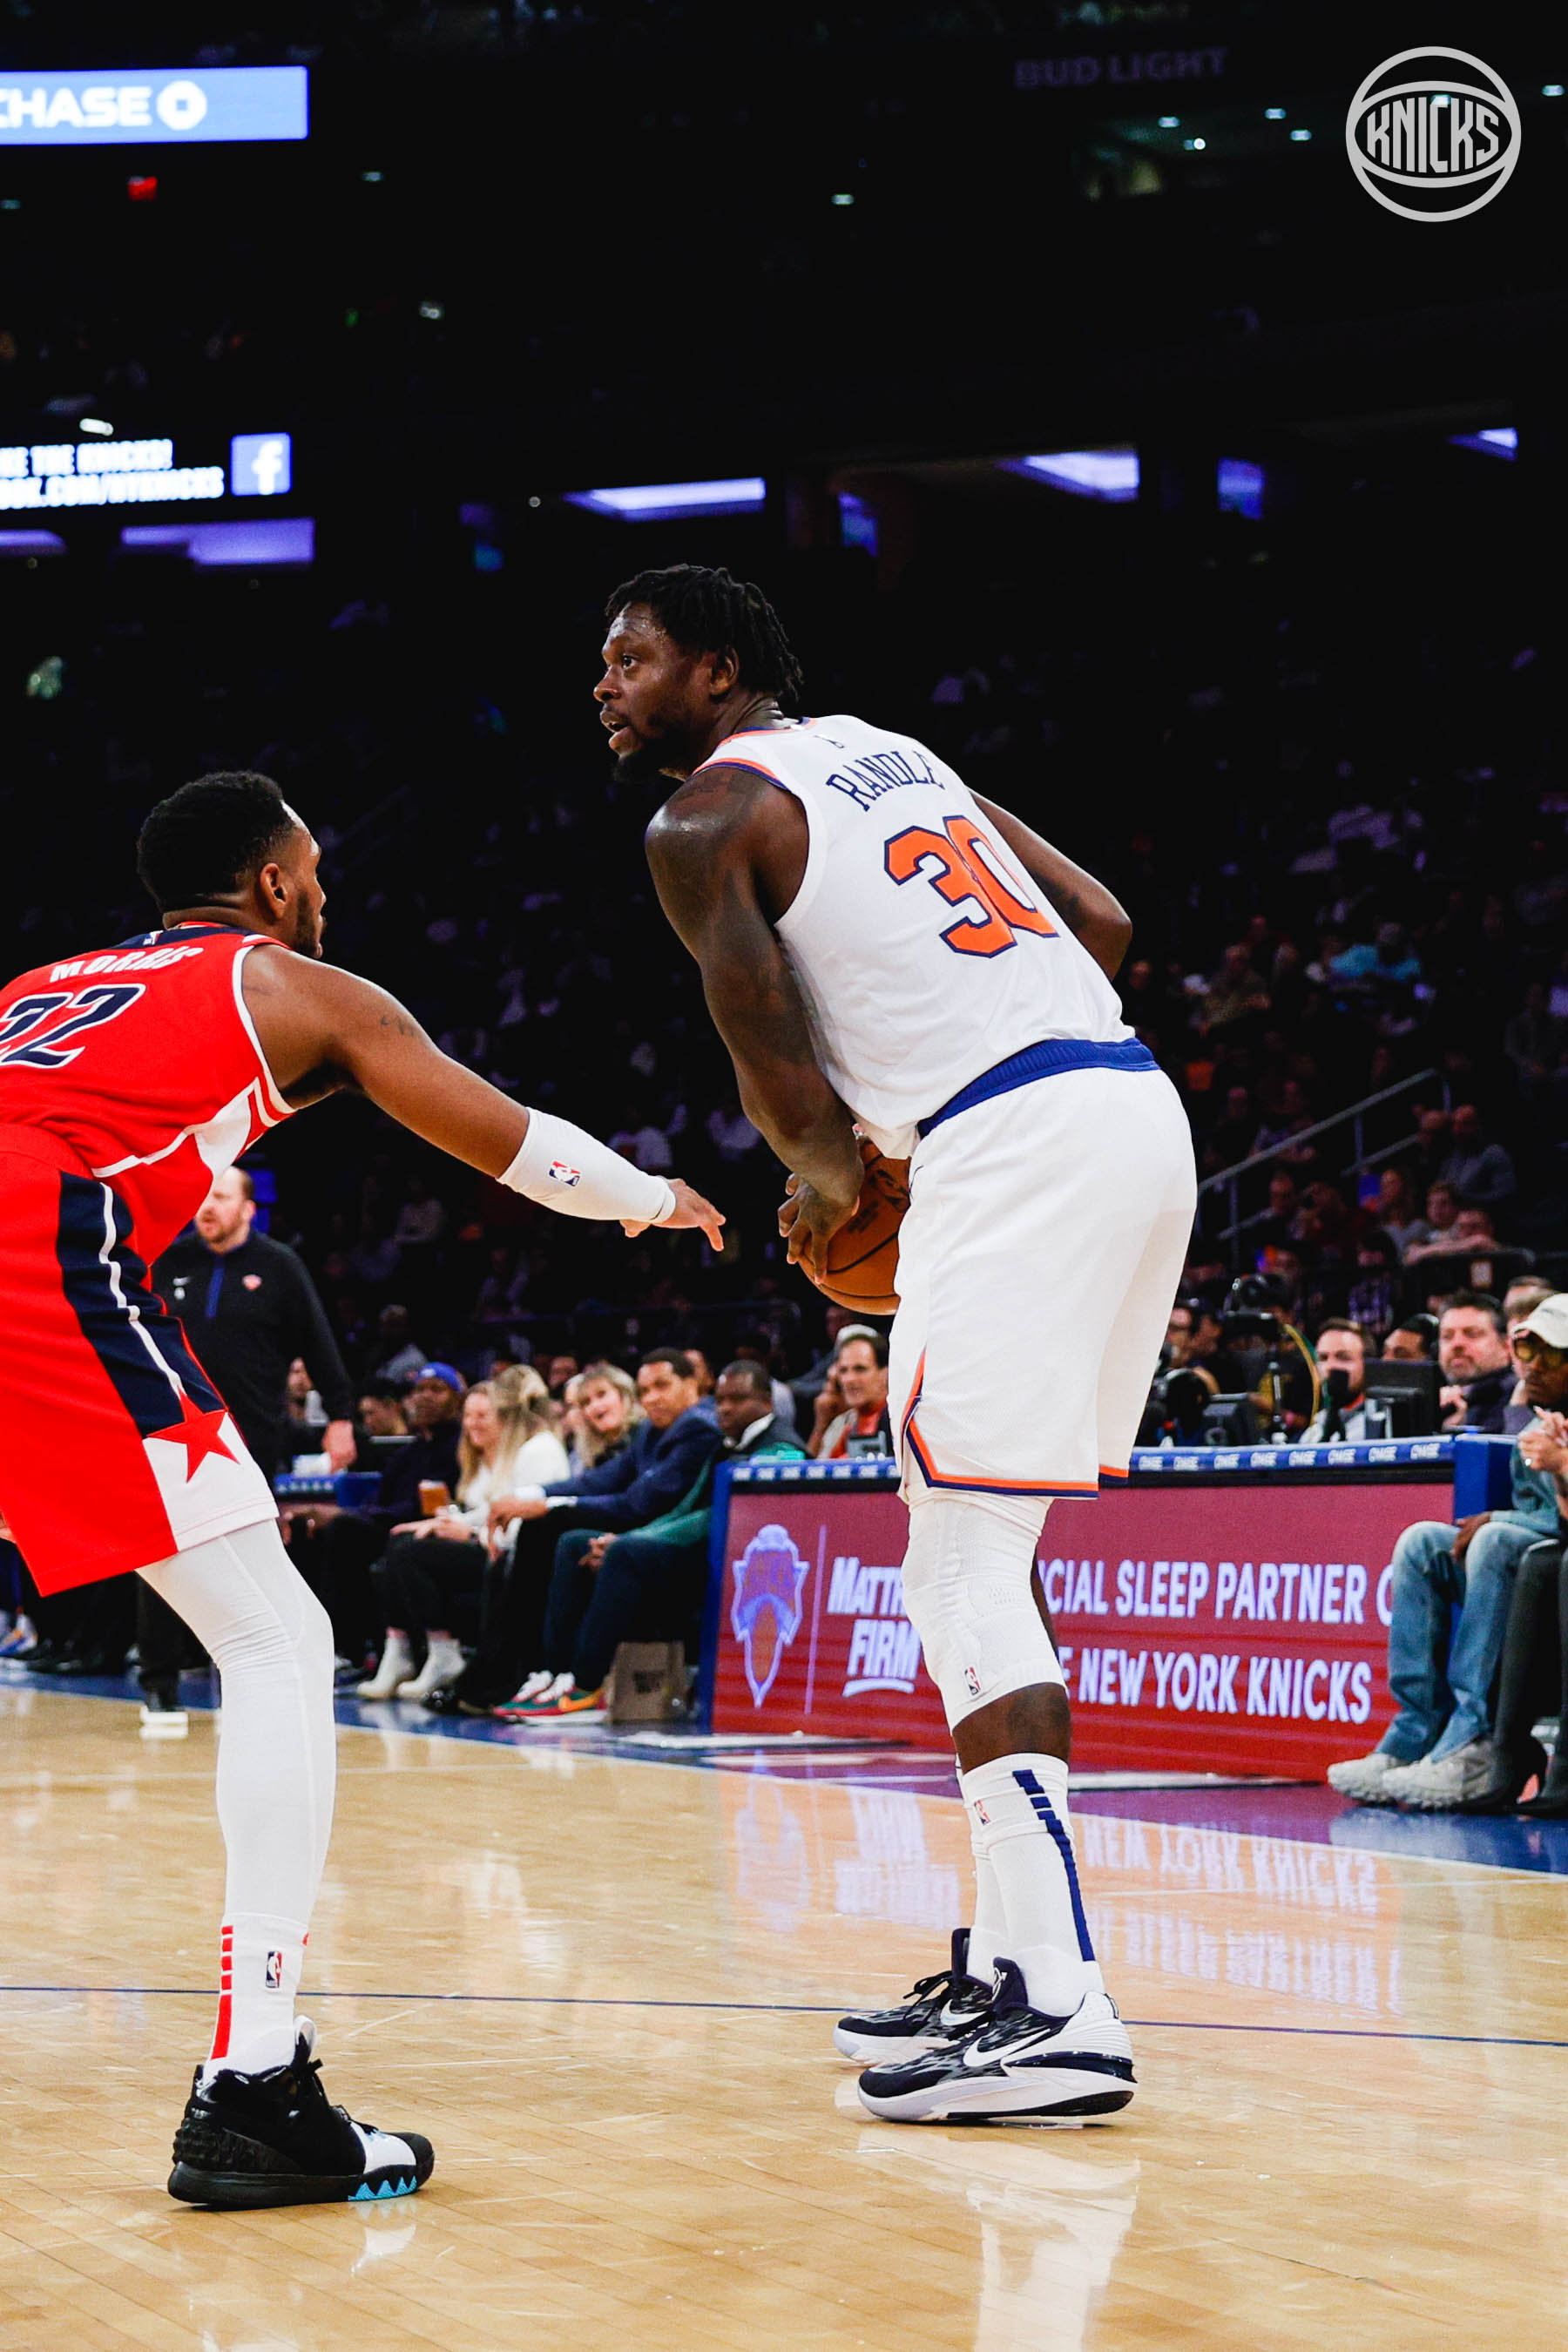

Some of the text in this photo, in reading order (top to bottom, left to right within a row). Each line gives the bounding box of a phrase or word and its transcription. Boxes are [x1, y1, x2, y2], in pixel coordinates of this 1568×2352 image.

[1015, 46, 1229, 89] BUD LIGHT
[883, 814, 1061, 959] 30
[1114, 1558, 1210, 1619] SLEEP
[1214, 1562, 1368, 1625] PARTNER
[846, 1619, 922, 1680] FIRM
[1078, 1646, 1148, 1707] NEW
[1152, 1650, 1240, 1715] YORK
[1246, 1655, 1372, 1725] KNICKS
